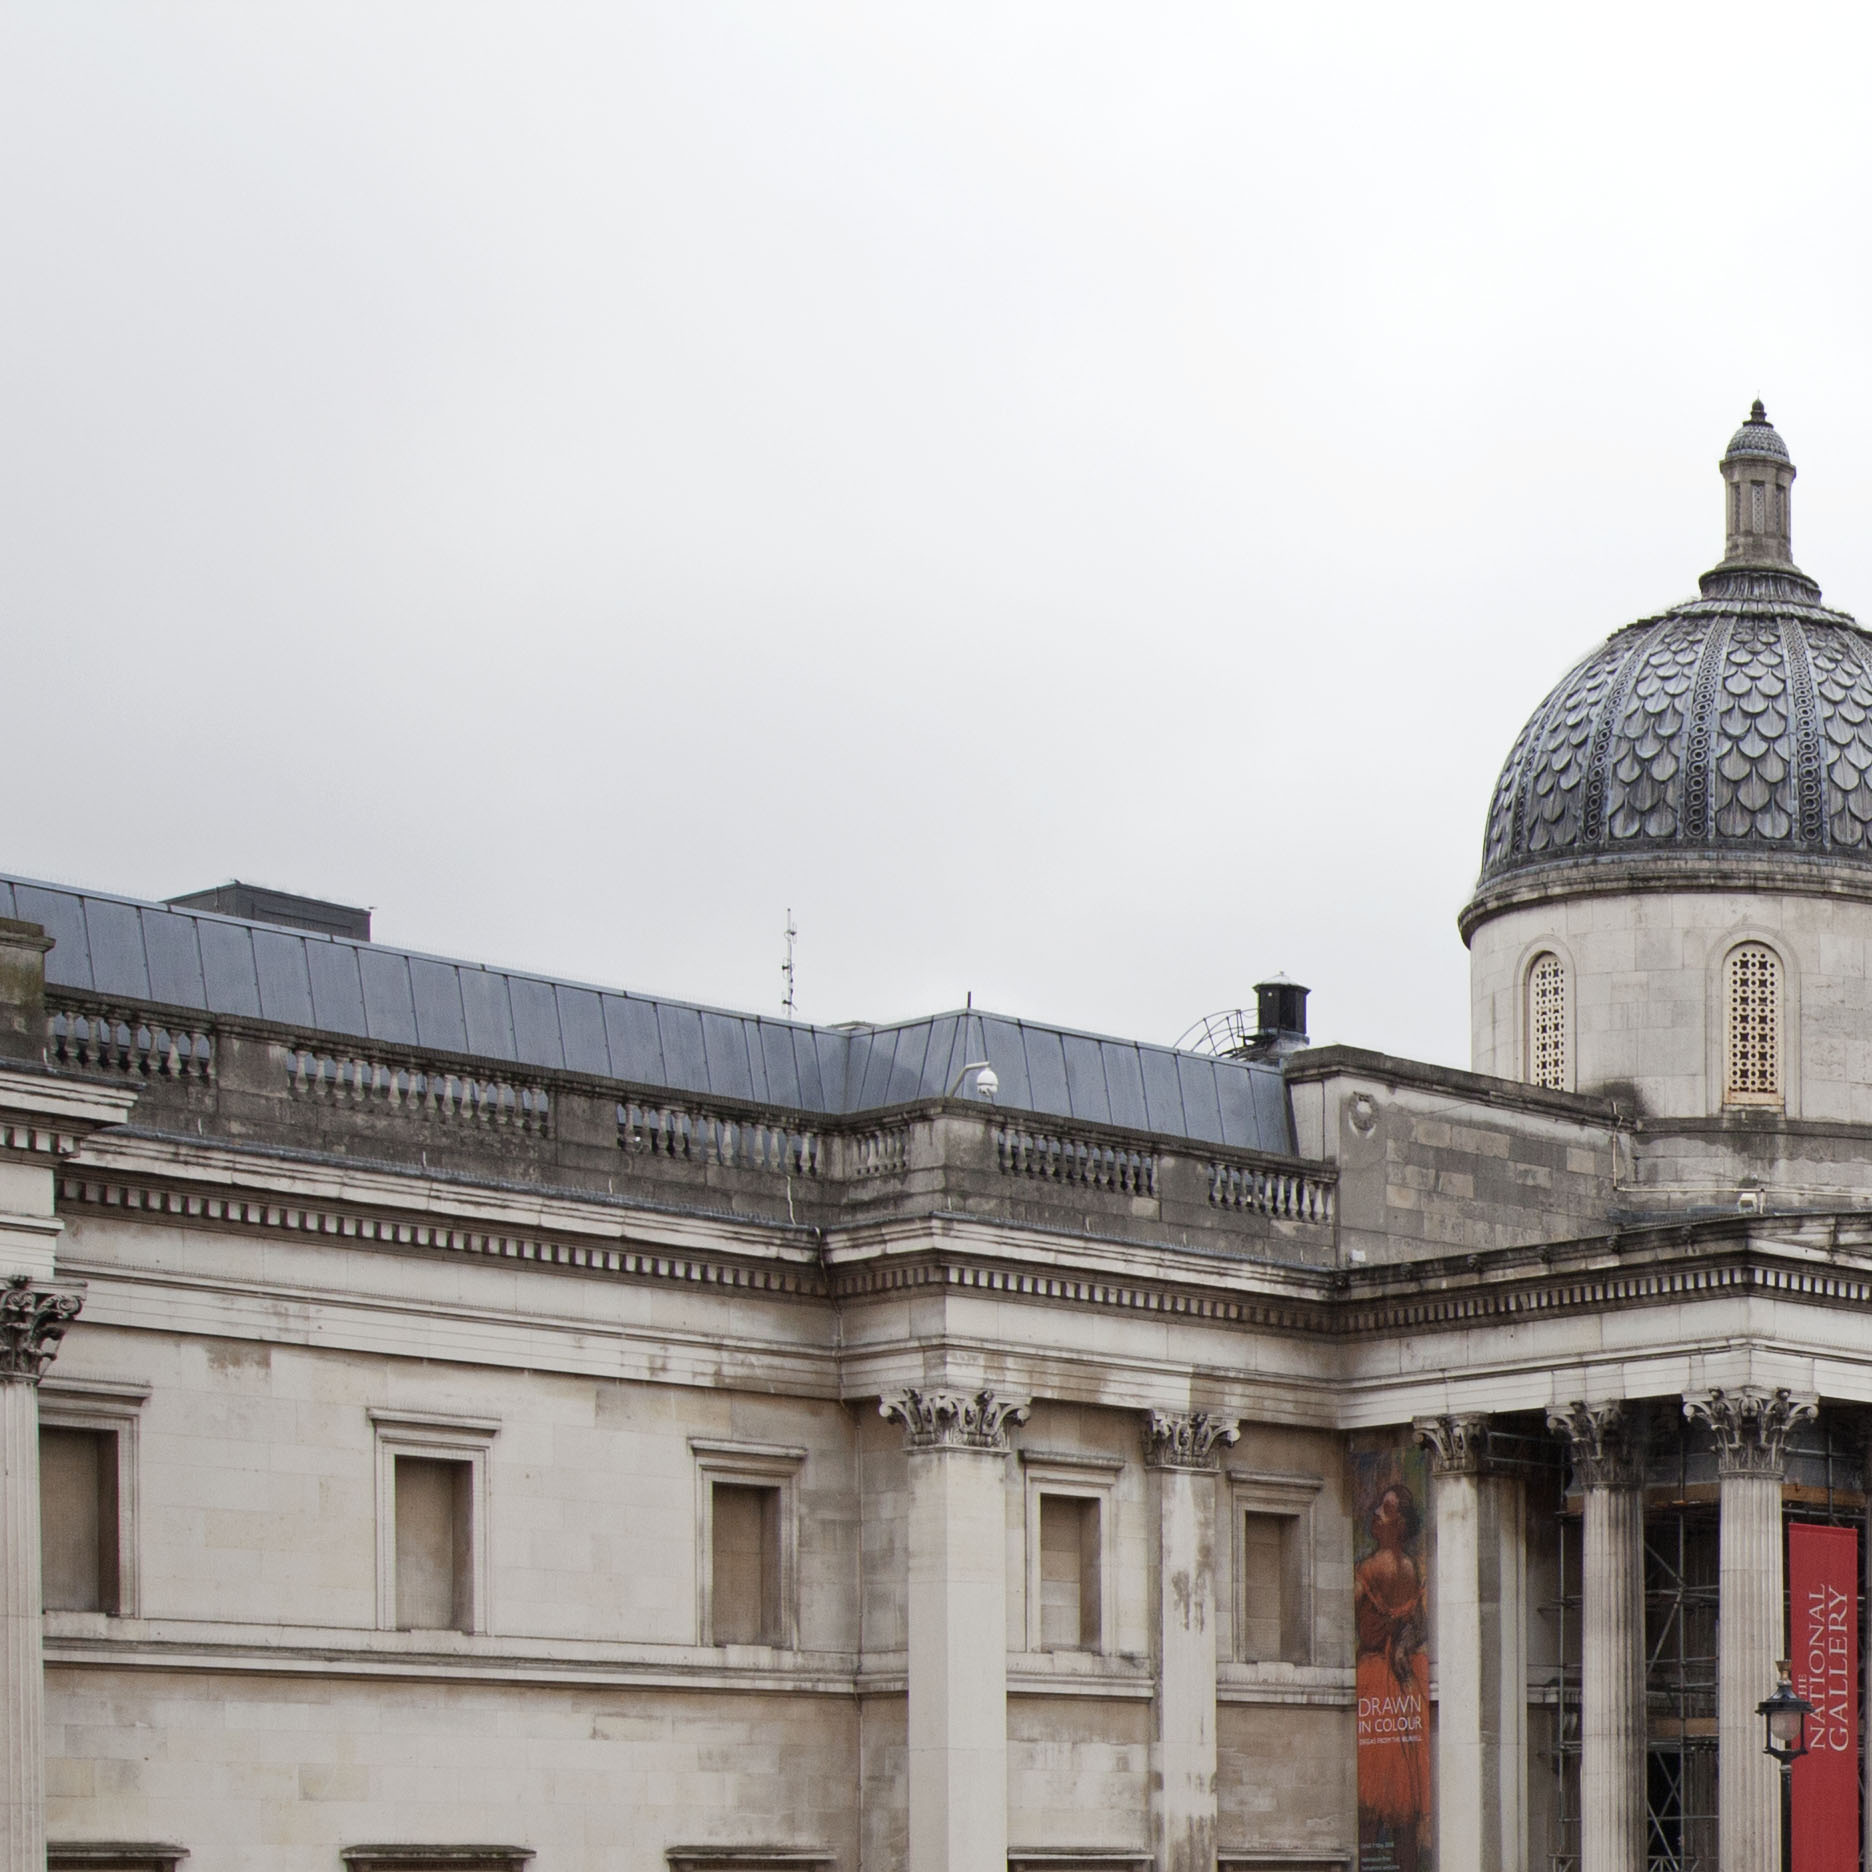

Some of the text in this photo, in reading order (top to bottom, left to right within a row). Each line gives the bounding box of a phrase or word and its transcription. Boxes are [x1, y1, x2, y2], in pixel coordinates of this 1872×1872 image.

[1808, 1584, 1826, 1749] NATIONAL
[1828, 1585, 1849, 1752] GALLERY
[1798, 1674, 1807, 1696] HE
[1358, 1694, 1422, 1717] DRAWN
[1358, 1715, 1423, 1734] IN COLOUR
